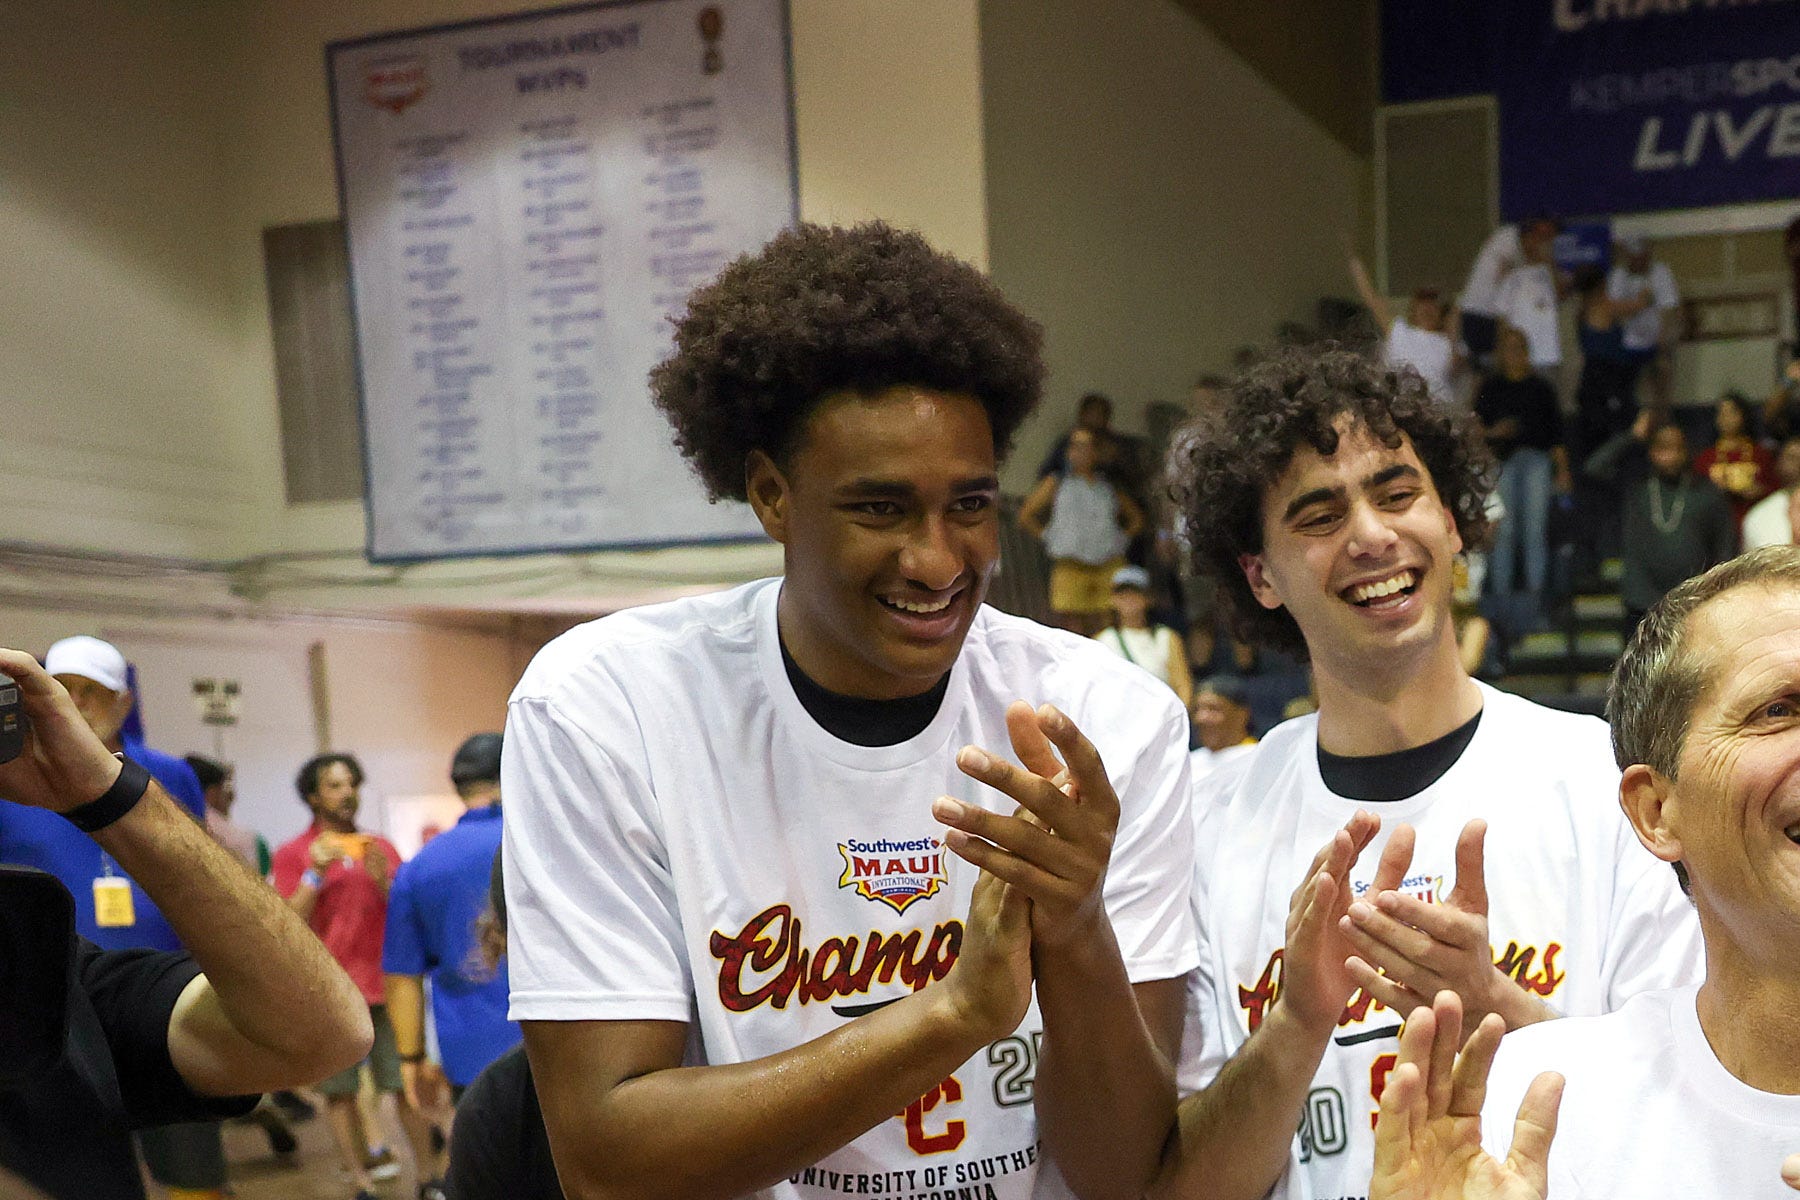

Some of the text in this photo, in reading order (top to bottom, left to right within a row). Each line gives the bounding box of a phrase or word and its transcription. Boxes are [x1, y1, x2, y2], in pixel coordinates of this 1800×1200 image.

[848, 837, 931, 853] Southwest
[852, 854, 940, 877] MAUI
[710, 904, 966, 1012] Champ
[986, 1030, 1044, 1109] 2
[925, 1165, 948, 1188] OF
[956, 1140, 1042, 1184] SOUTHE
